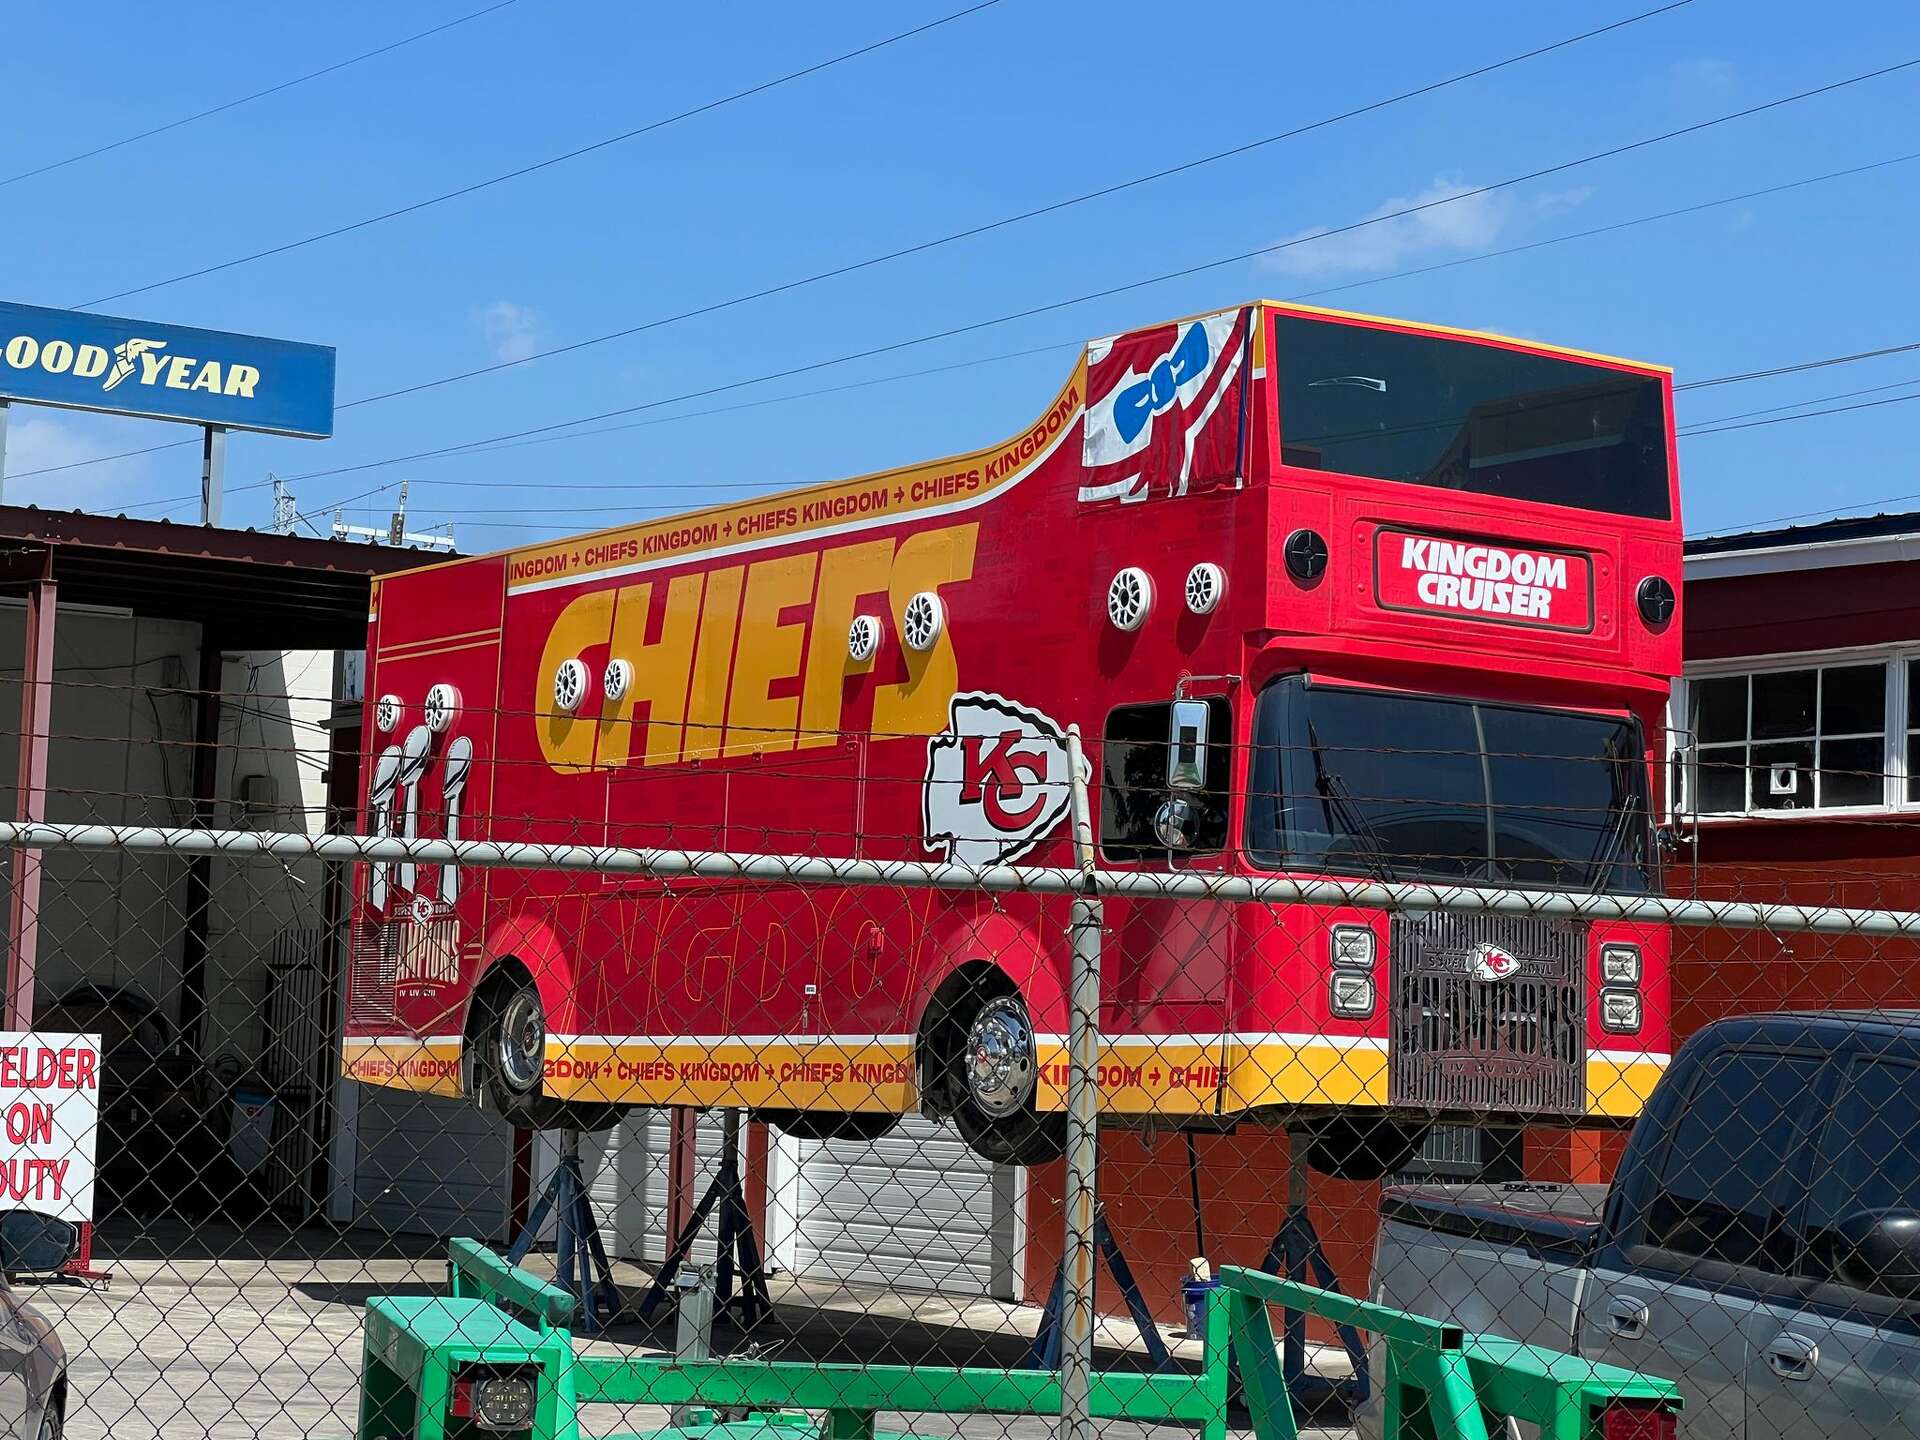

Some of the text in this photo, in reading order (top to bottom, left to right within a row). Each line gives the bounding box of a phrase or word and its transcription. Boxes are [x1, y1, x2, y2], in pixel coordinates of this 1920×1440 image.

[0, 335, 260, 398] OODYEAR
[585, 539, 638, 566] CHIEFS
[642, 523, 718, 555] KINGDOM
[737, 507, 797, 536] CHIEFS
[802, 486, 888, 524] KINGDOM
[911, 470, 980, 502] CHIEFS
[985, 387, 1079, 485] KINGDOM
[1401, 537, 1567, 590] KINGDOM
[1417, 573, 1552, 619] CRUISER
[535, 522, 980, 775] CHIEFS
[959, 729, 1048, 832] KC
[0, 1046, 97, 1089] ELDER
[617, 1062, 675, 1081] CHIEFS
[680, 1061, 760, 1082] KINGDOM
[780, 1062, 844, 1083] CHIEFS
[6, 1102, 53, 1145] ON
